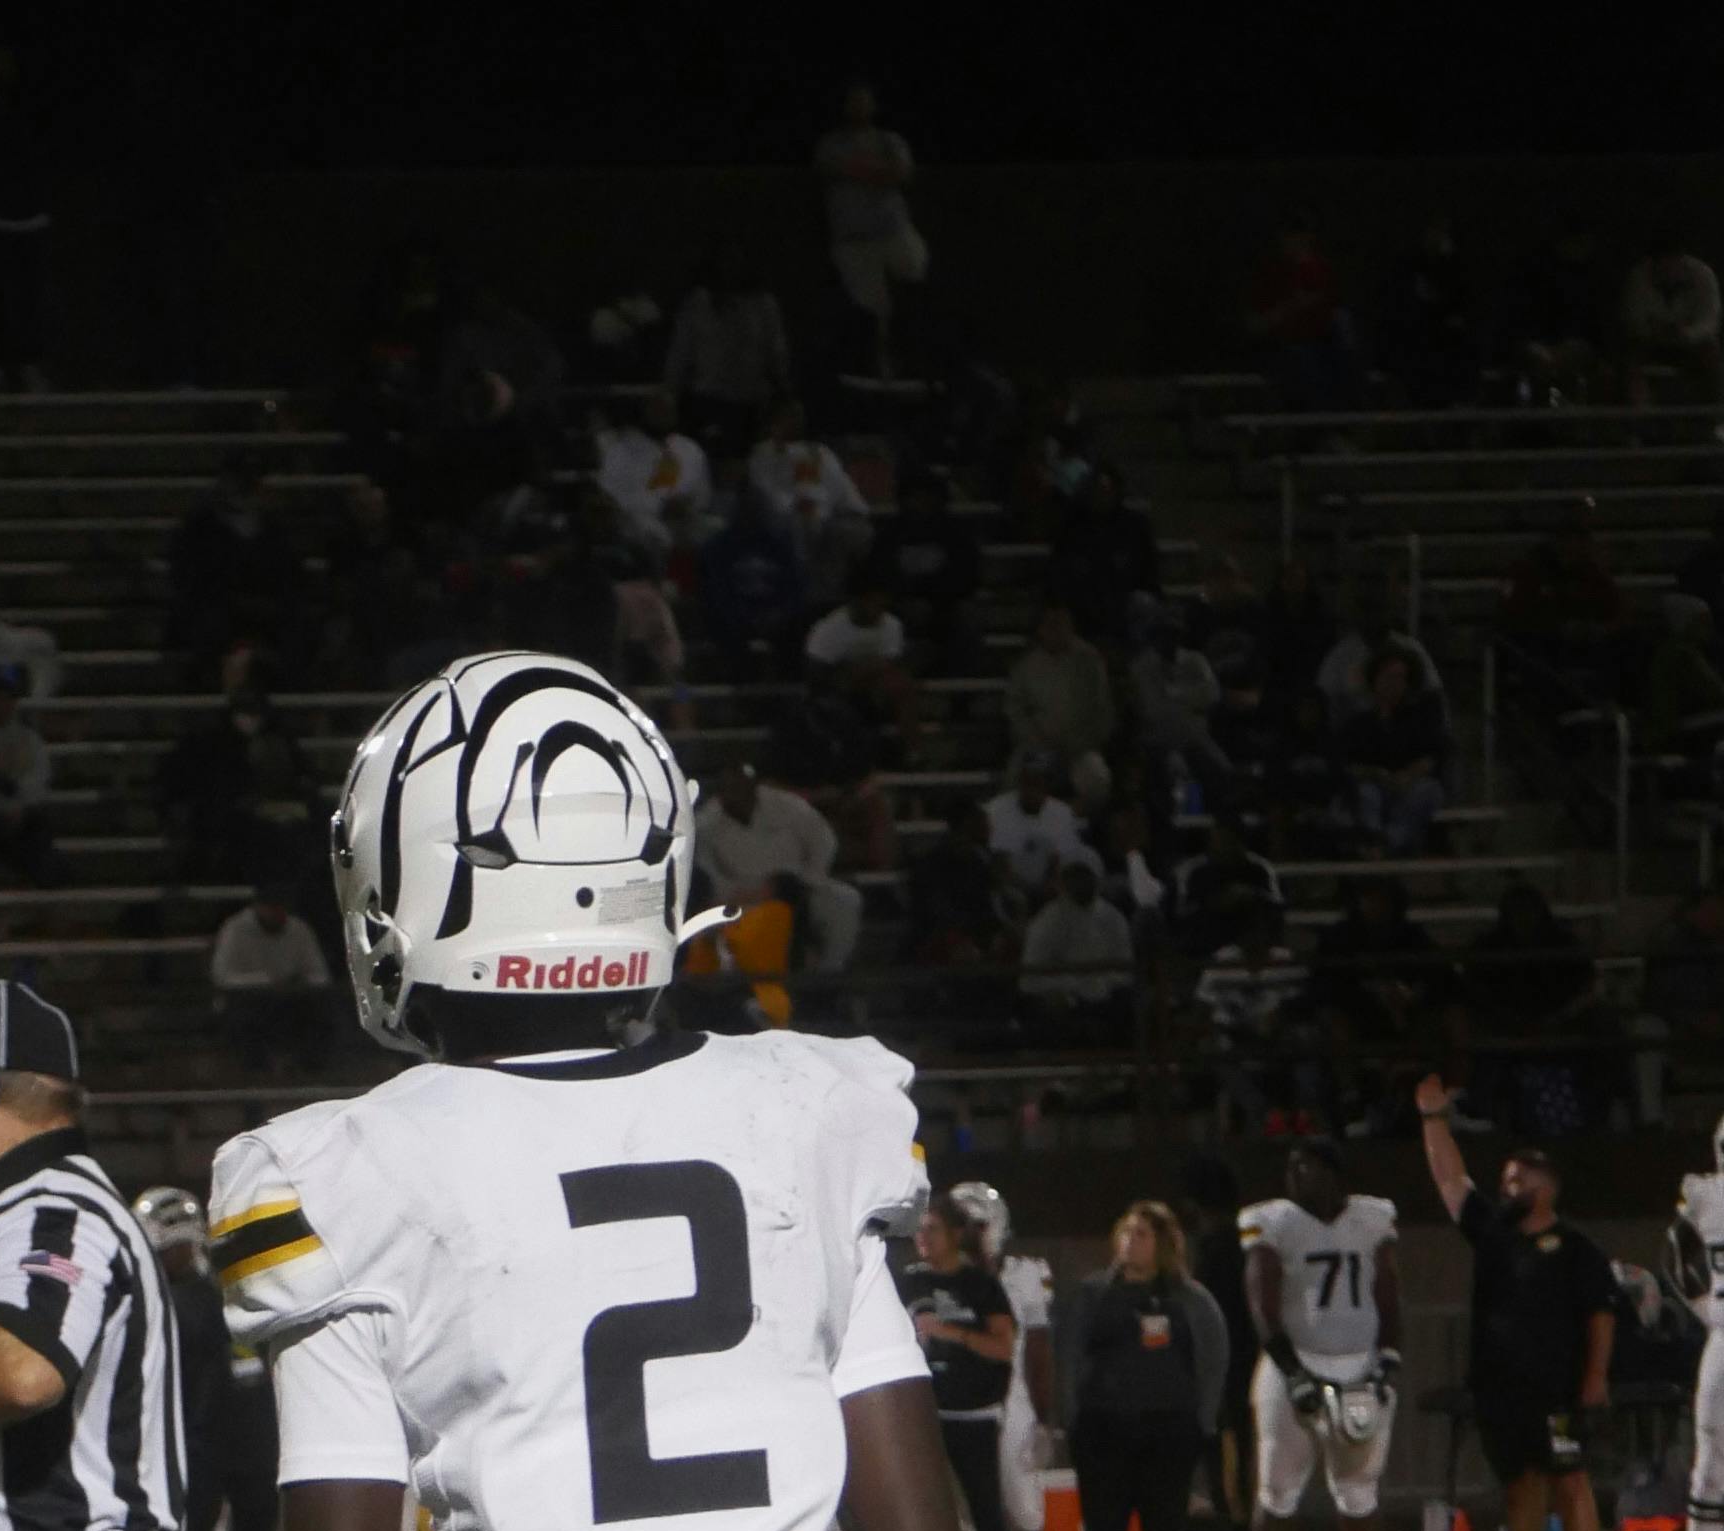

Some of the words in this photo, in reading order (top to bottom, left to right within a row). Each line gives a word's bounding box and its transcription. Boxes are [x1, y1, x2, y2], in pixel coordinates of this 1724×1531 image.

[496, 950, 650, 990] Riddell
[1304, 1249, 1362, 1309] 71
[558, 1159, 772, 1526] 2
